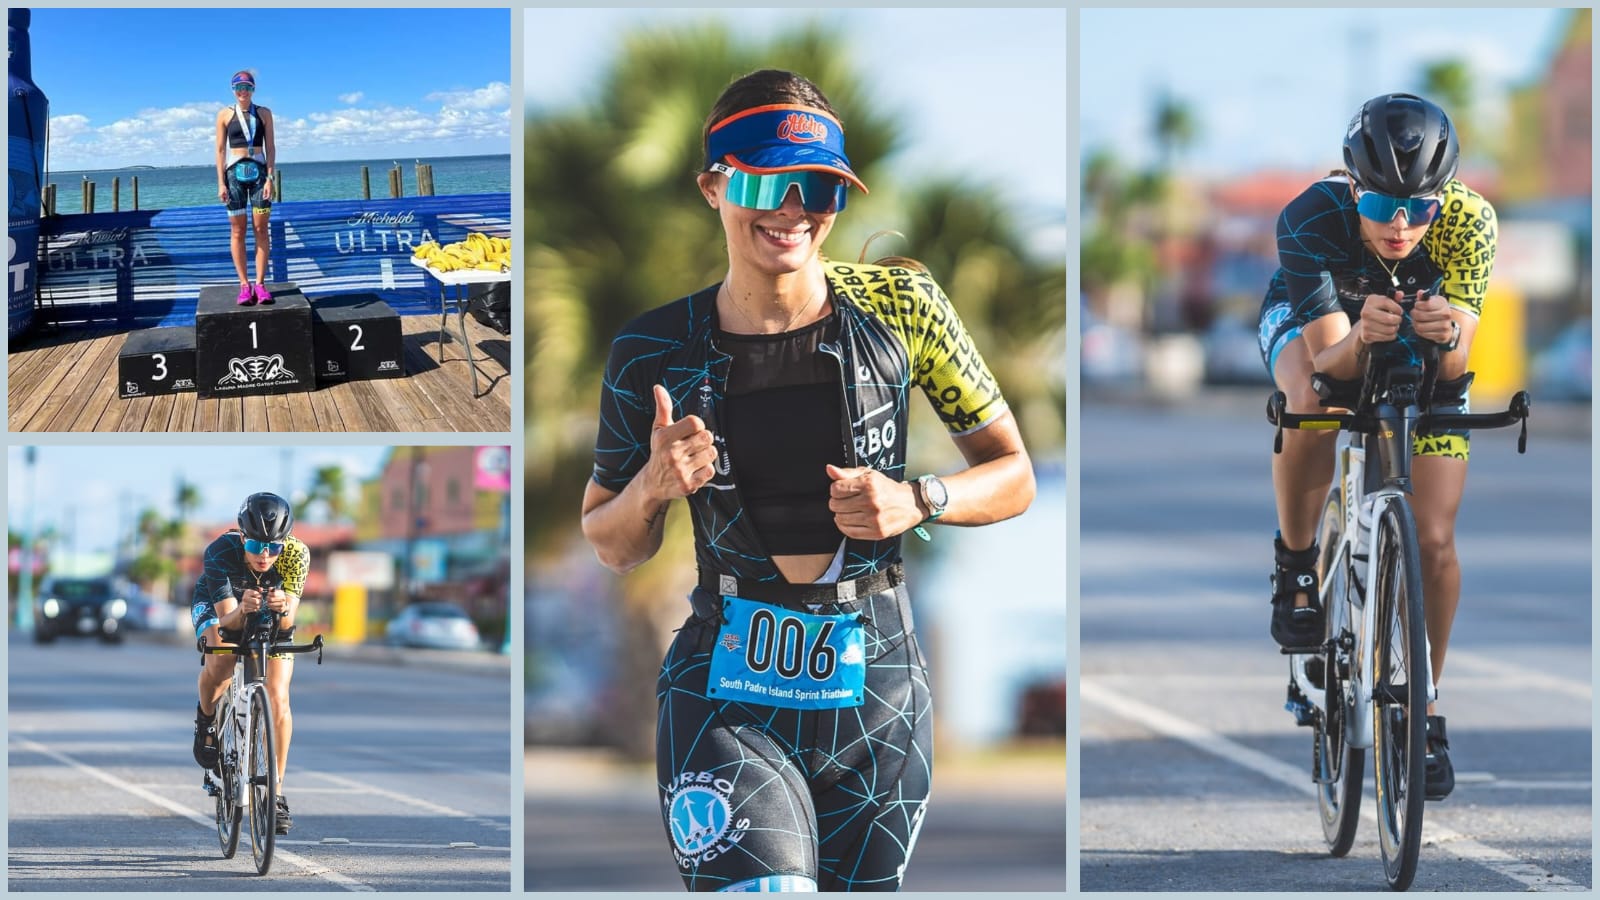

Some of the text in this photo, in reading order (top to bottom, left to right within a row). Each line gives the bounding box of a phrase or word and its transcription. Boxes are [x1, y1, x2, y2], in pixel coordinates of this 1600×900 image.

[777, 113, 828, 143] Aloha
[347, 210, 415, 226] Michelob
[335, 229, 434, 253] ULTRA
[47, 245, 149, 271] ULTRA
[1456, 265, 1492, 280] TEA
[834, 265, 877, 314] URBO
[889, 268, 915, 343] TURB
[249, 321, 258, 349] 1
[348, 325, 365, 351] 2
[152, 353, 168, 381] 3
[745, 608, 837, 682] 006
[720, 677, 854, 702] South Padre Island Sprint Triathlon
